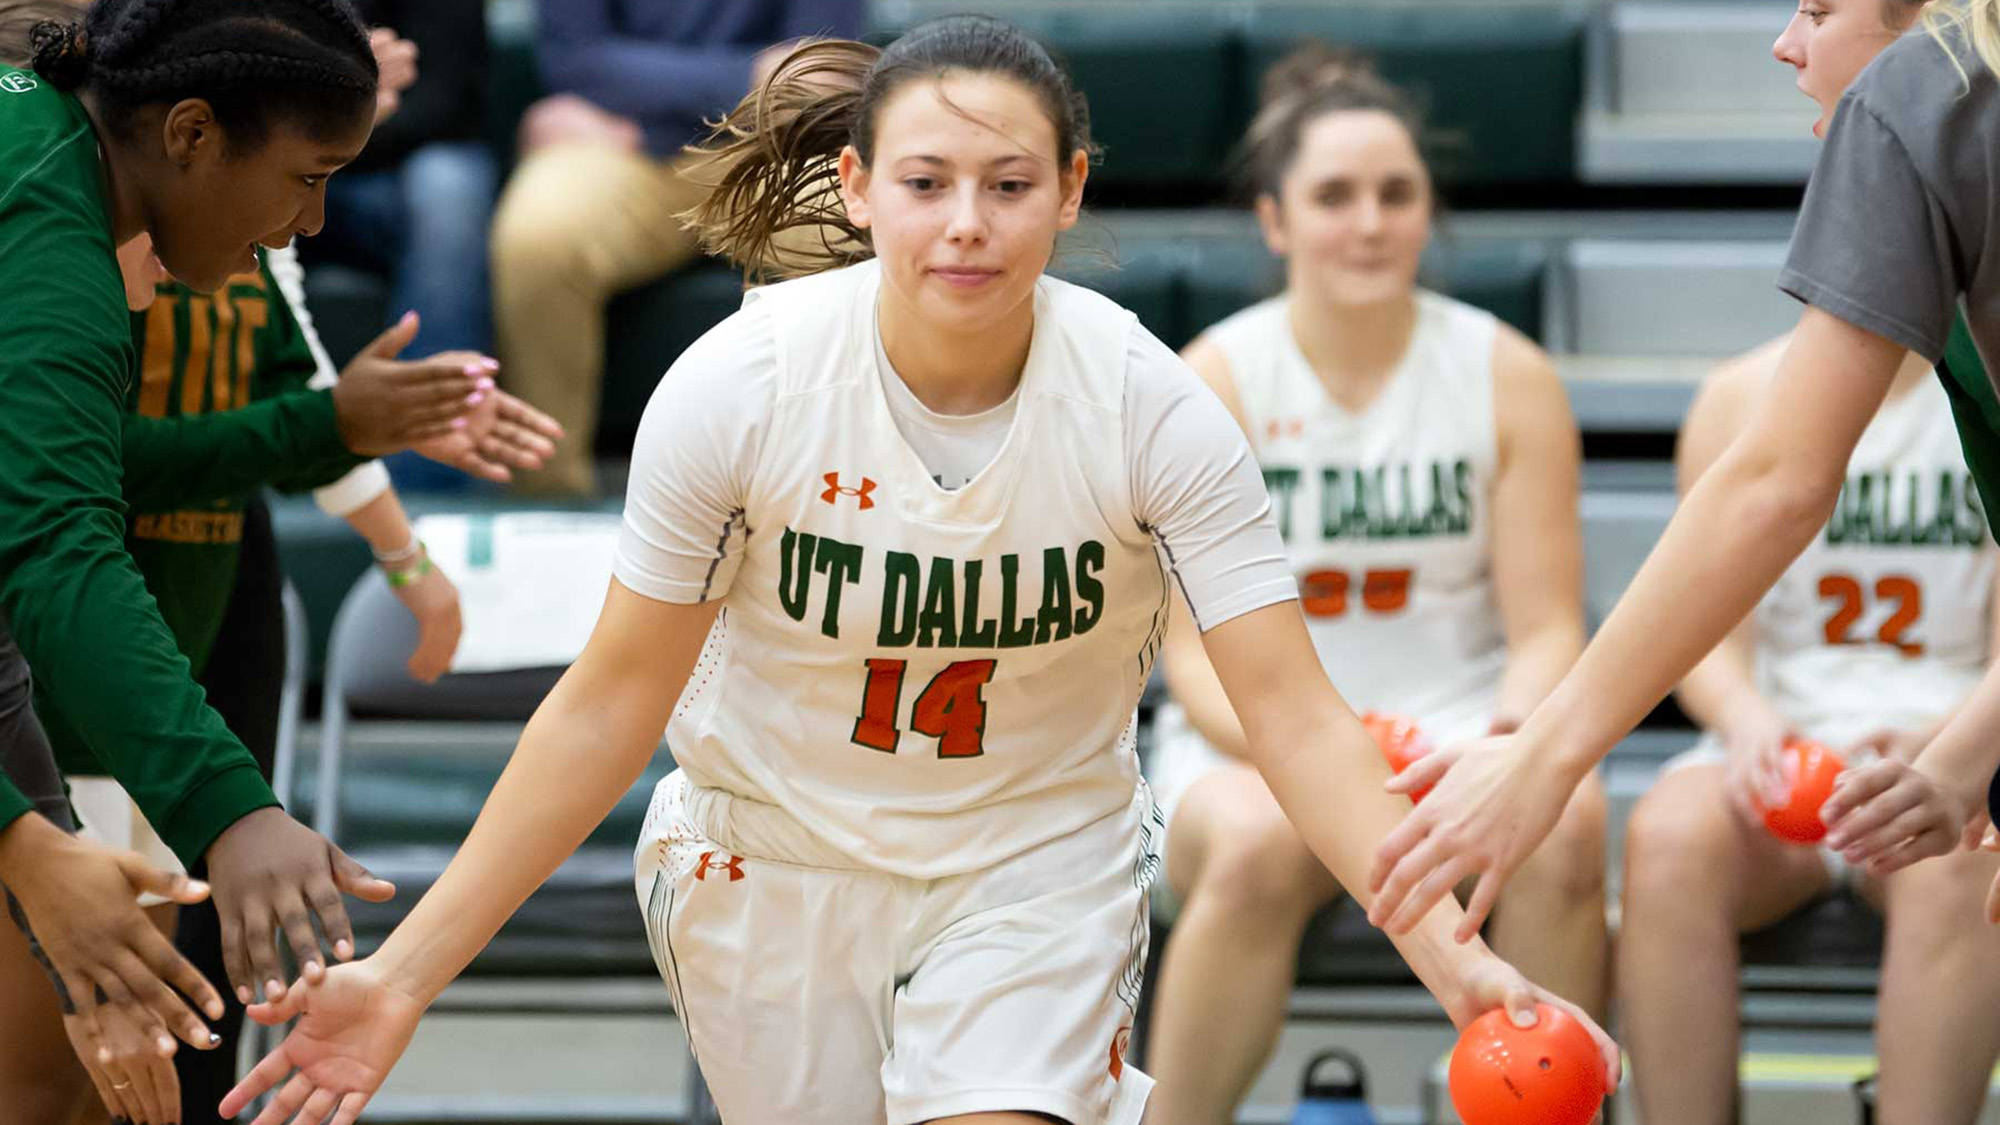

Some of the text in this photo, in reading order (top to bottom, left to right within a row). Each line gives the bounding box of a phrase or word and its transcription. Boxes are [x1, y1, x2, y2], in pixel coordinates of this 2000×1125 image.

[1261, 459, 1471, 540] T DALLAS
[778, 527, 1105, 649] UT DALLAS
[1817, 573, 1924, 657] 22
[850, 657, 998, 760] 14
